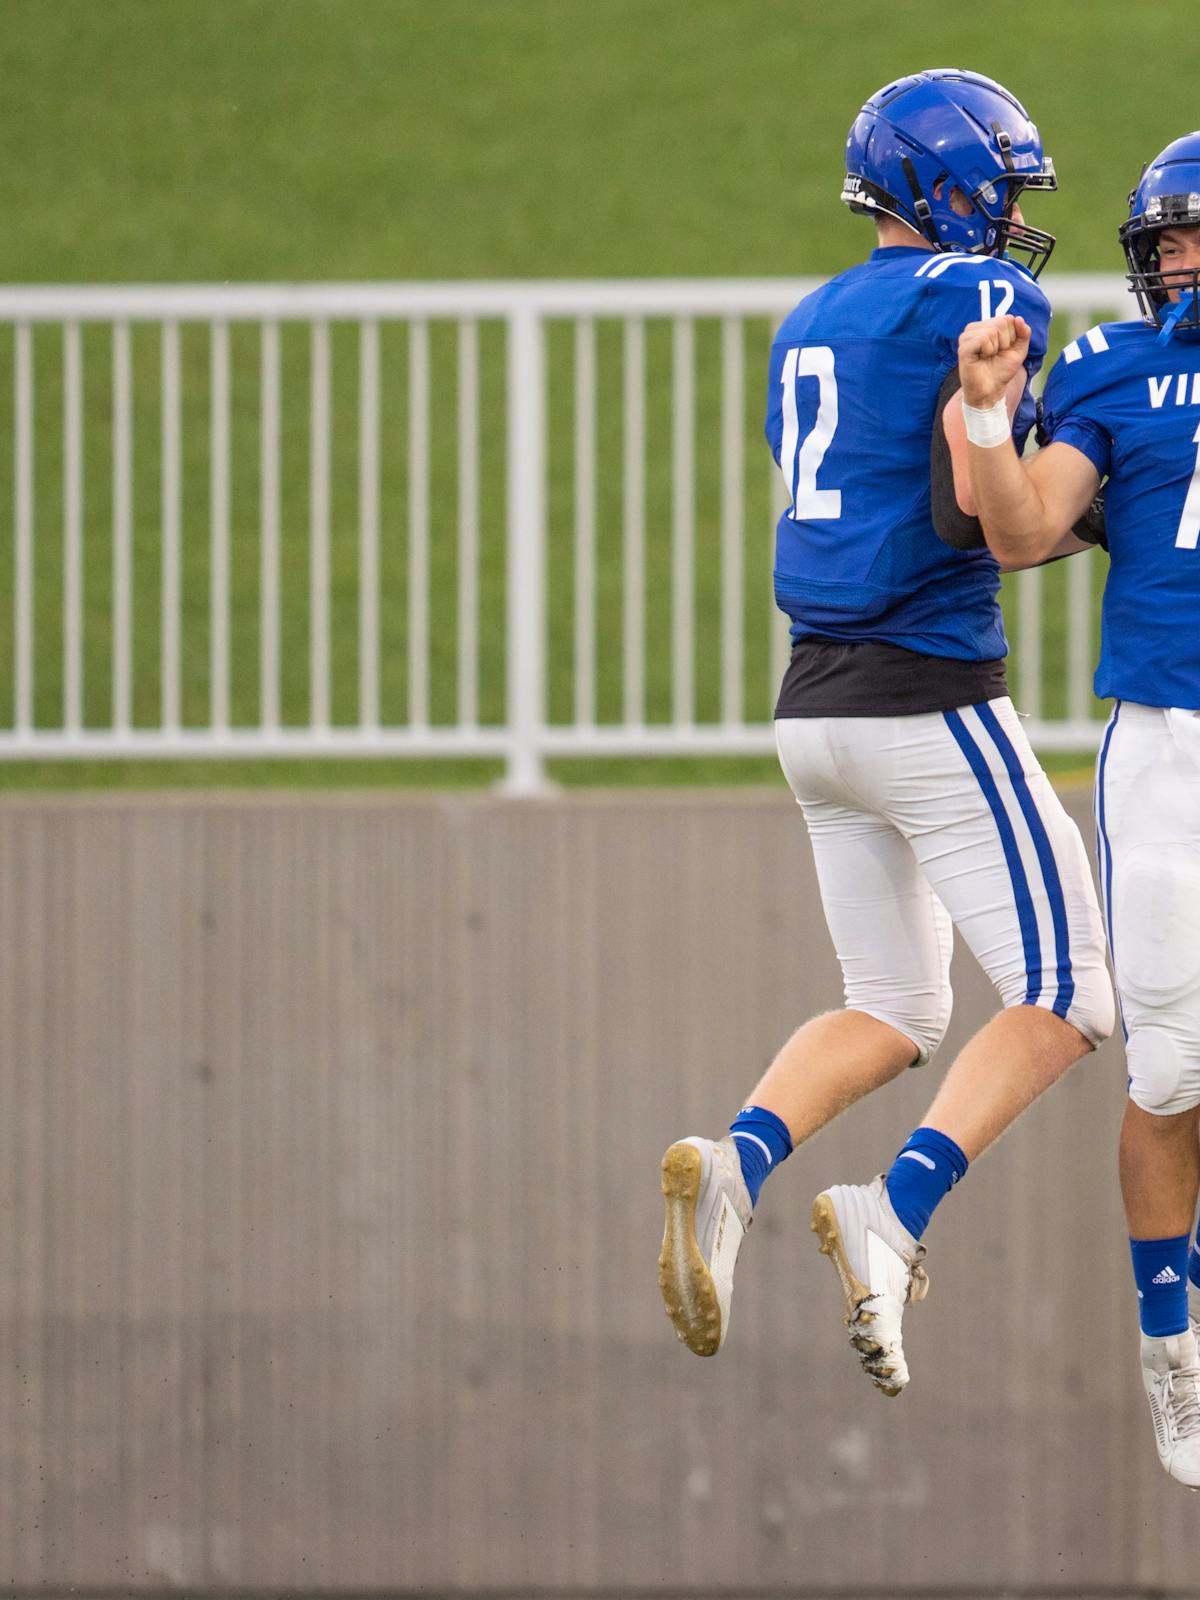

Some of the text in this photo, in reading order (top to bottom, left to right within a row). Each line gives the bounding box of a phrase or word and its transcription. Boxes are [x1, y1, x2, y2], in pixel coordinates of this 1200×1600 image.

[977, 279, 1015, 320] 12
[780, 346, 842, 521] 12
[1152, 1274, 1180, 1284] adidas
